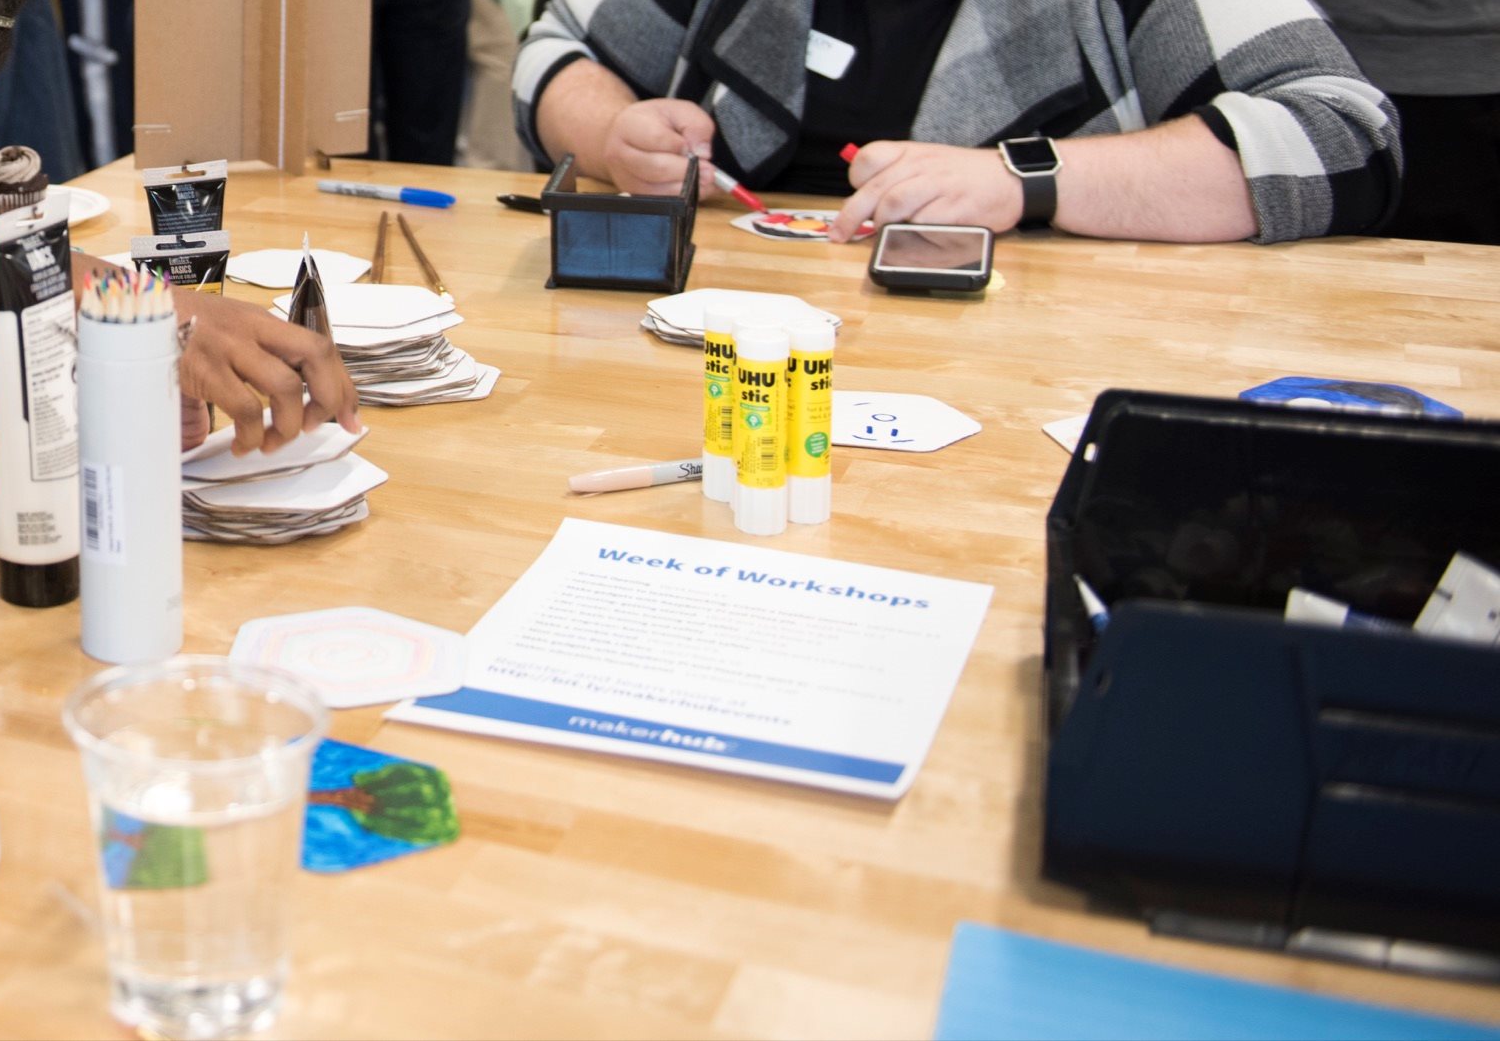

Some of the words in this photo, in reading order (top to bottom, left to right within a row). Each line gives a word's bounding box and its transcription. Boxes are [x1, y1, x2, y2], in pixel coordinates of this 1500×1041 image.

[170, 264, 192, 274] BASICS
[705, 360, 729, 374] stic
[804, 358, 833, 375] UH
[738, 367, 776, 388] UHU
[810, 376, 832, 391] sti
[741, 389, 770, 404] stic
[597, 547, 684, 572] Week
[693, 565, 732, 578] of
[737, 569, 930, 609] Workshops
[568, 715, 727, 752] makerhub
